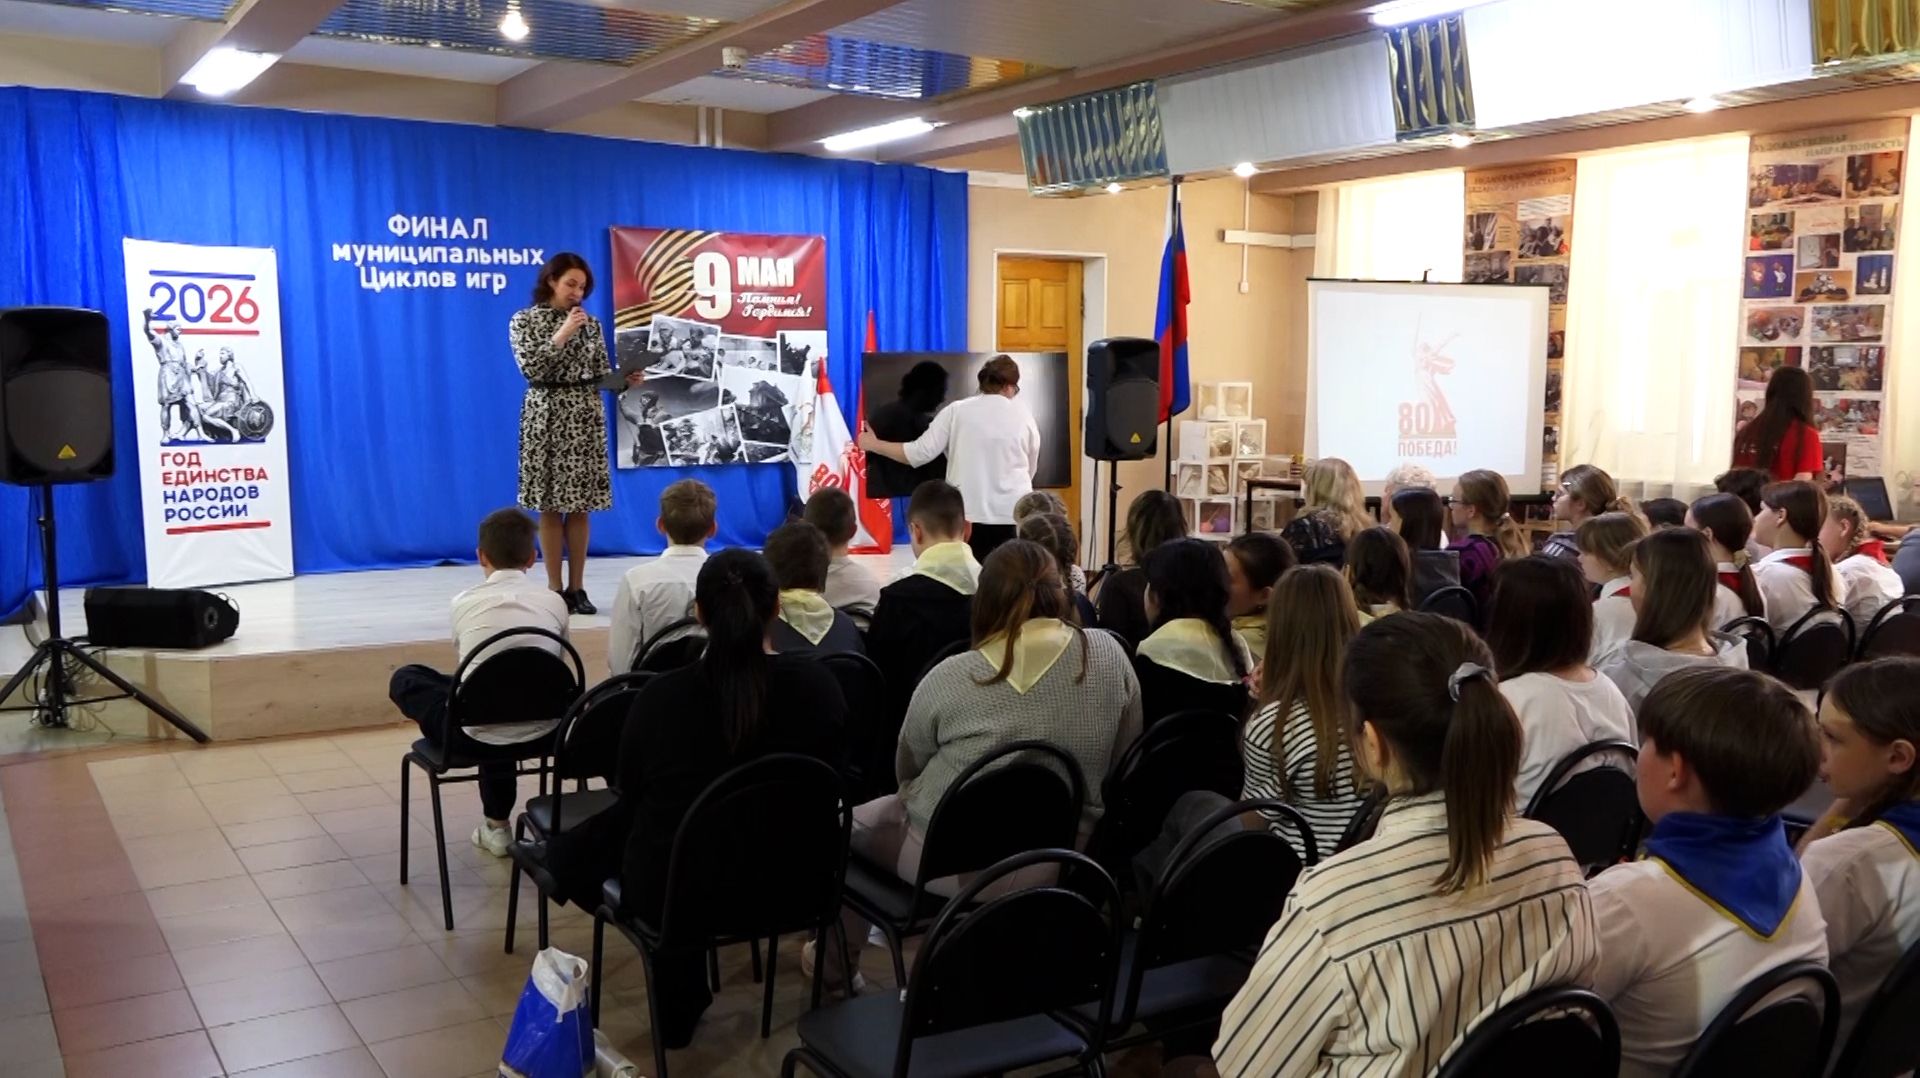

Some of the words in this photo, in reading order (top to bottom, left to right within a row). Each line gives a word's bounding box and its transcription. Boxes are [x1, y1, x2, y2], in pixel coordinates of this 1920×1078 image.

[387, 214, 488, 241] ФИНАЛ
[331, 243, 545, 267] муниципальных
[360, 266, 457, 293] Циклов
[465, 272, 507, 295] игр
[693, 252, 732, 320] 9
[736, 256, 795, 288] МАЯ
[149, 281, 260, 325] 2026
[1398, 401, 1431, 434] 80
[160, 452, 202, 468] ГОД
[1398, 440, 1457, 458] ПОБЕДА!
[162, 467, 269, 487] ЕДИНСТВА
[163, 485, 260, 504] НАРОДОВ
[164, 504, 249, 522] РОССИИ
